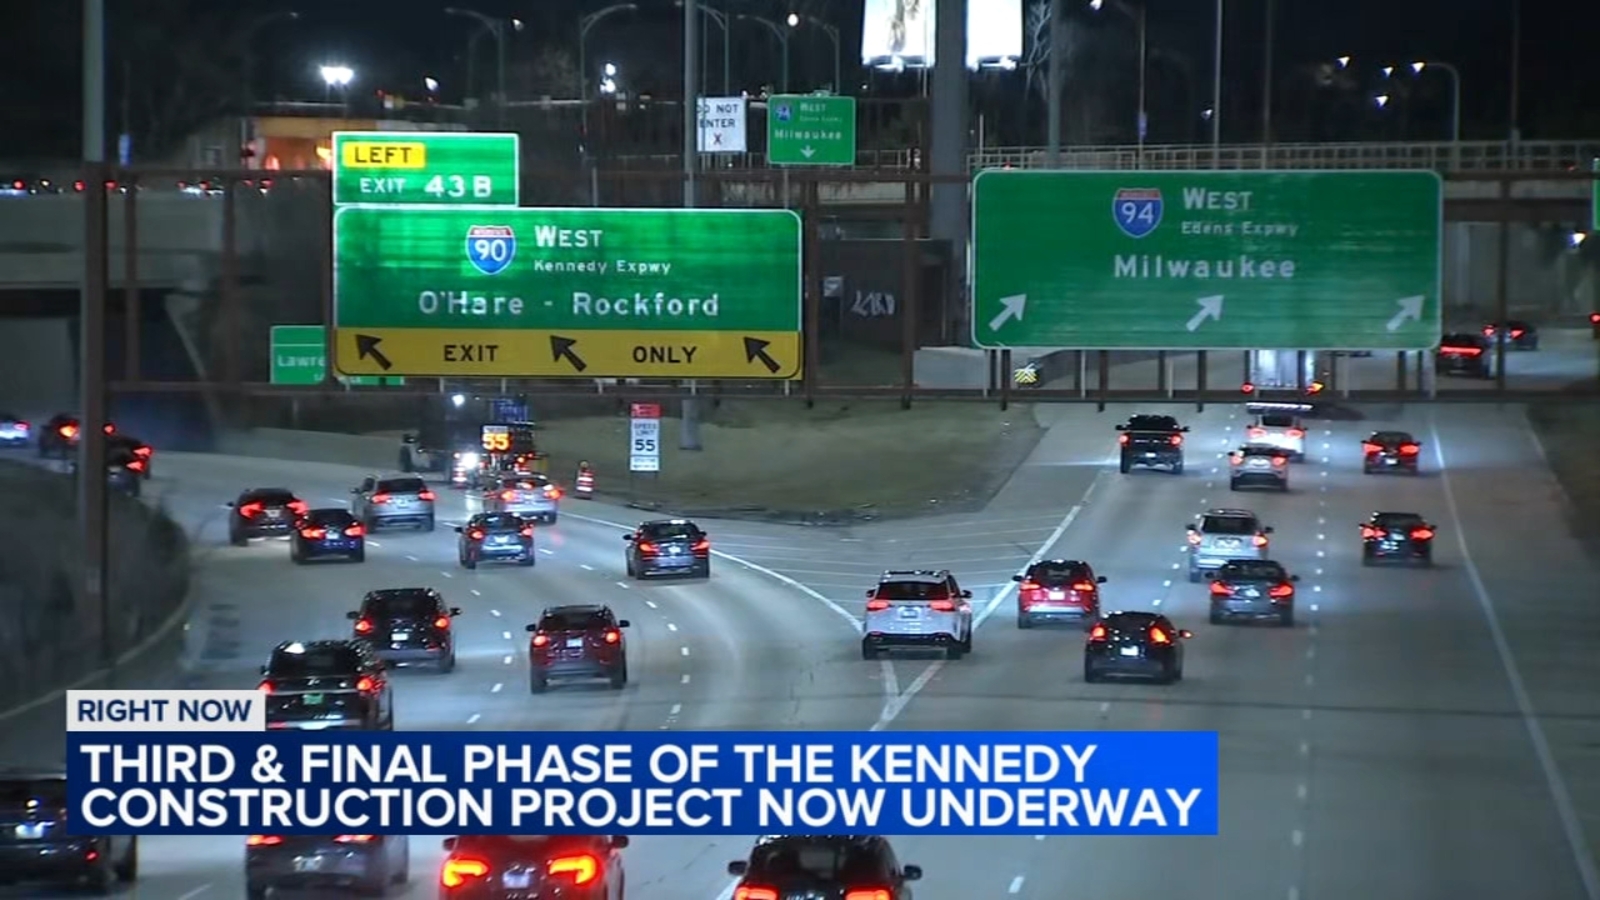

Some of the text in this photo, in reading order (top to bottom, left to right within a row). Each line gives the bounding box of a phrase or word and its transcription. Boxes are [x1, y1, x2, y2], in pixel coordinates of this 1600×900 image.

[716, 104, 738, 114] NOT
[775, 130, 841, 140] Milwaukee
[355, 147, 413, 164] LEFT
[360, 178, 405, 194] EXIT
[1183, 188, 1252, 210] WEST
[1122, 202, 1154, 224] 94
[535, 226, 602, 248] WEST
[1182, 222, 1297, 237] Edens Expwy
[475, 239, 506, 261] 90
[534, 260, 671, 275] Kennedy Expwy
[1114, 255, 1296, 279] Milwaukee
[419, 292, 524, 316] O'Hare
[572, 293, 719, 316] Rockford
[443, 345, 697, 363] EXIT ONLY
[482, 433, 509, 450] 55
[635, 439, 656, 452] 55
